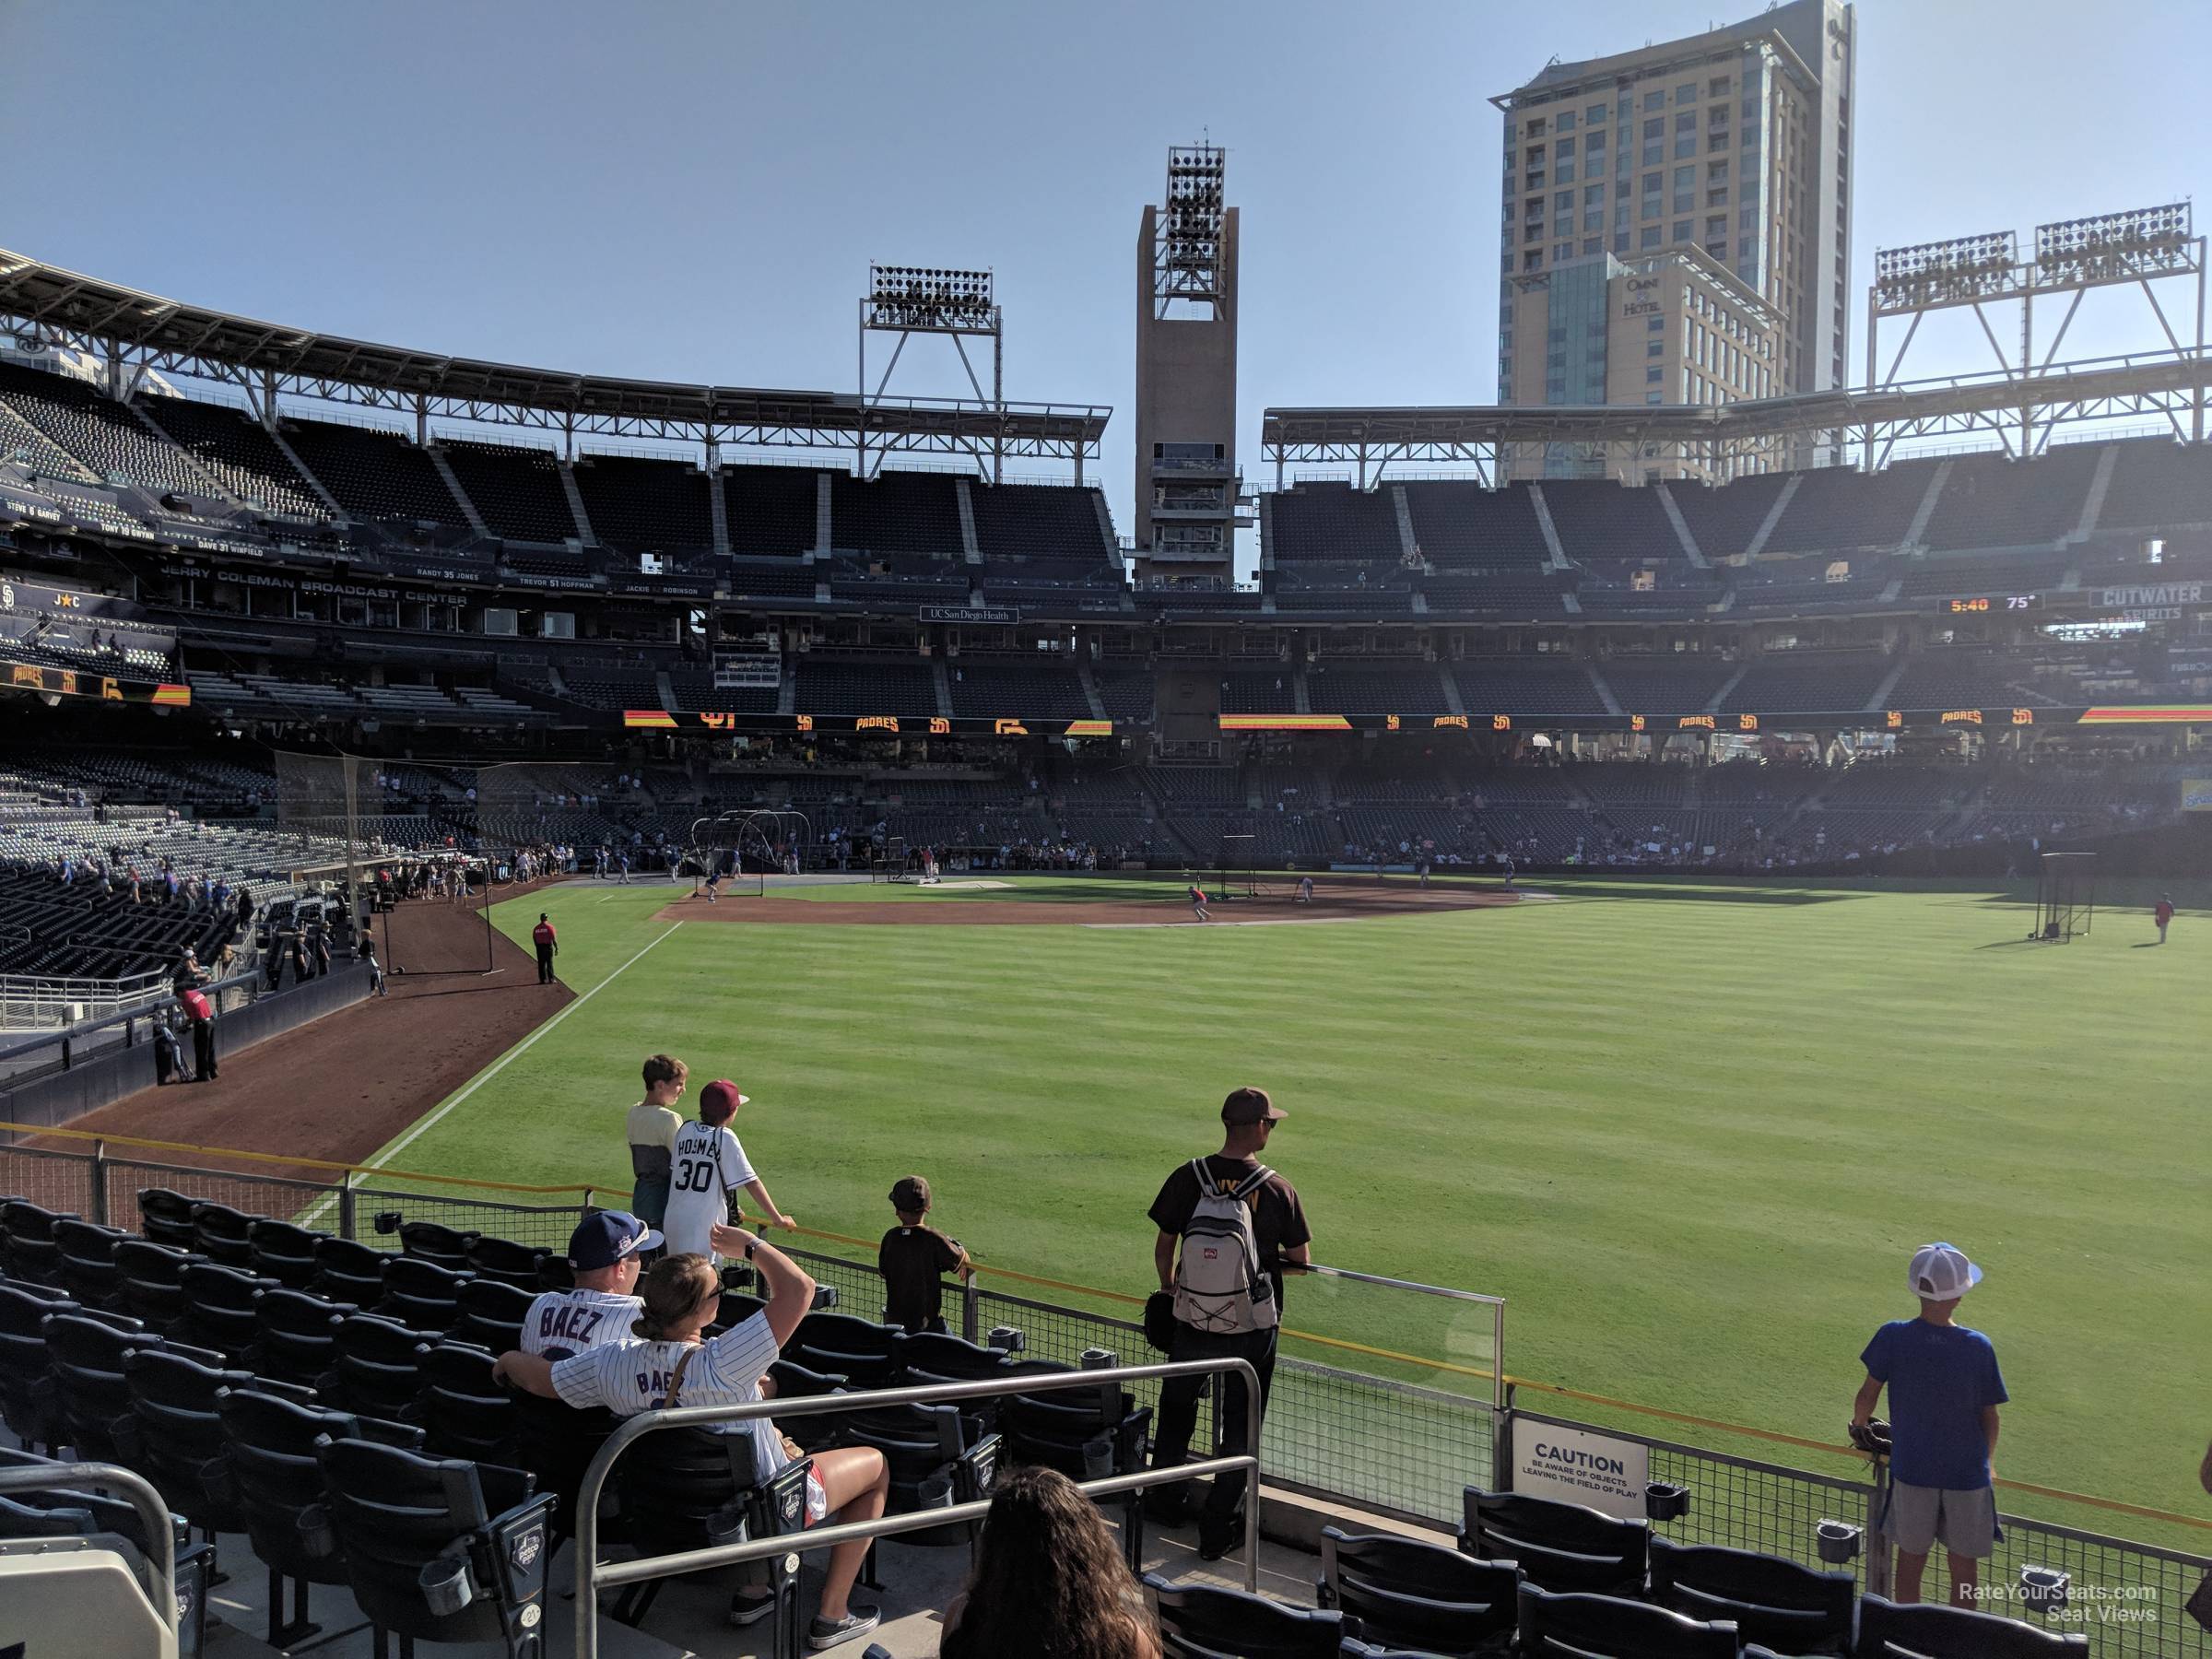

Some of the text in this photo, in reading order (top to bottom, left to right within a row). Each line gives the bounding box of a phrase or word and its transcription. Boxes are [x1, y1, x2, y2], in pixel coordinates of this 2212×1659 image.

[6, 500, 27, 513] STEVE
[37, 508, 61, 522] GARVEY
[100, 523, 155, 541] TONY 19 GWYNN
[198, 540, 264, 558] DAVE 31 WINFIELD
[417, 568, 479, 582] RANDY 35 JONES
[520, 578, 594, 590] TREVOR 51 HOFFMAN
[160, 565, 467, 606] JERRY COLEMAN BROADCAST CENTER
[625, 584, 650, 594] JACKIE
[663, 587, 699, 595] ROBINSON
[2102, 585, 2202, 606] CUTWATER
[930, 608, 1009, 621] UC San Diego Health
[1950, 598, 1989, 613] 5:40
[2123, 607, 2182, 620] SPIRITS
[14, 665, 43, 688] PADRES
[855, 715, 900, 733] PADRES
[1433, 715, 1469, 729] PADRES
[1678, 715, 1715, 729] PADRES
[1940, 710, 1983, 724] PADRES
[675, 1159, 714, 1194] 30
[539, 1305, 605, 1344] BAEZ
[1535, 1442, 1624, 1476] CAUTION
[1532, 1459, 1628, 1488] BE AWARE OF OBJECTS
[1522, 1466, 1638, 1500] LEAVING THE FIELD OF PLAY
